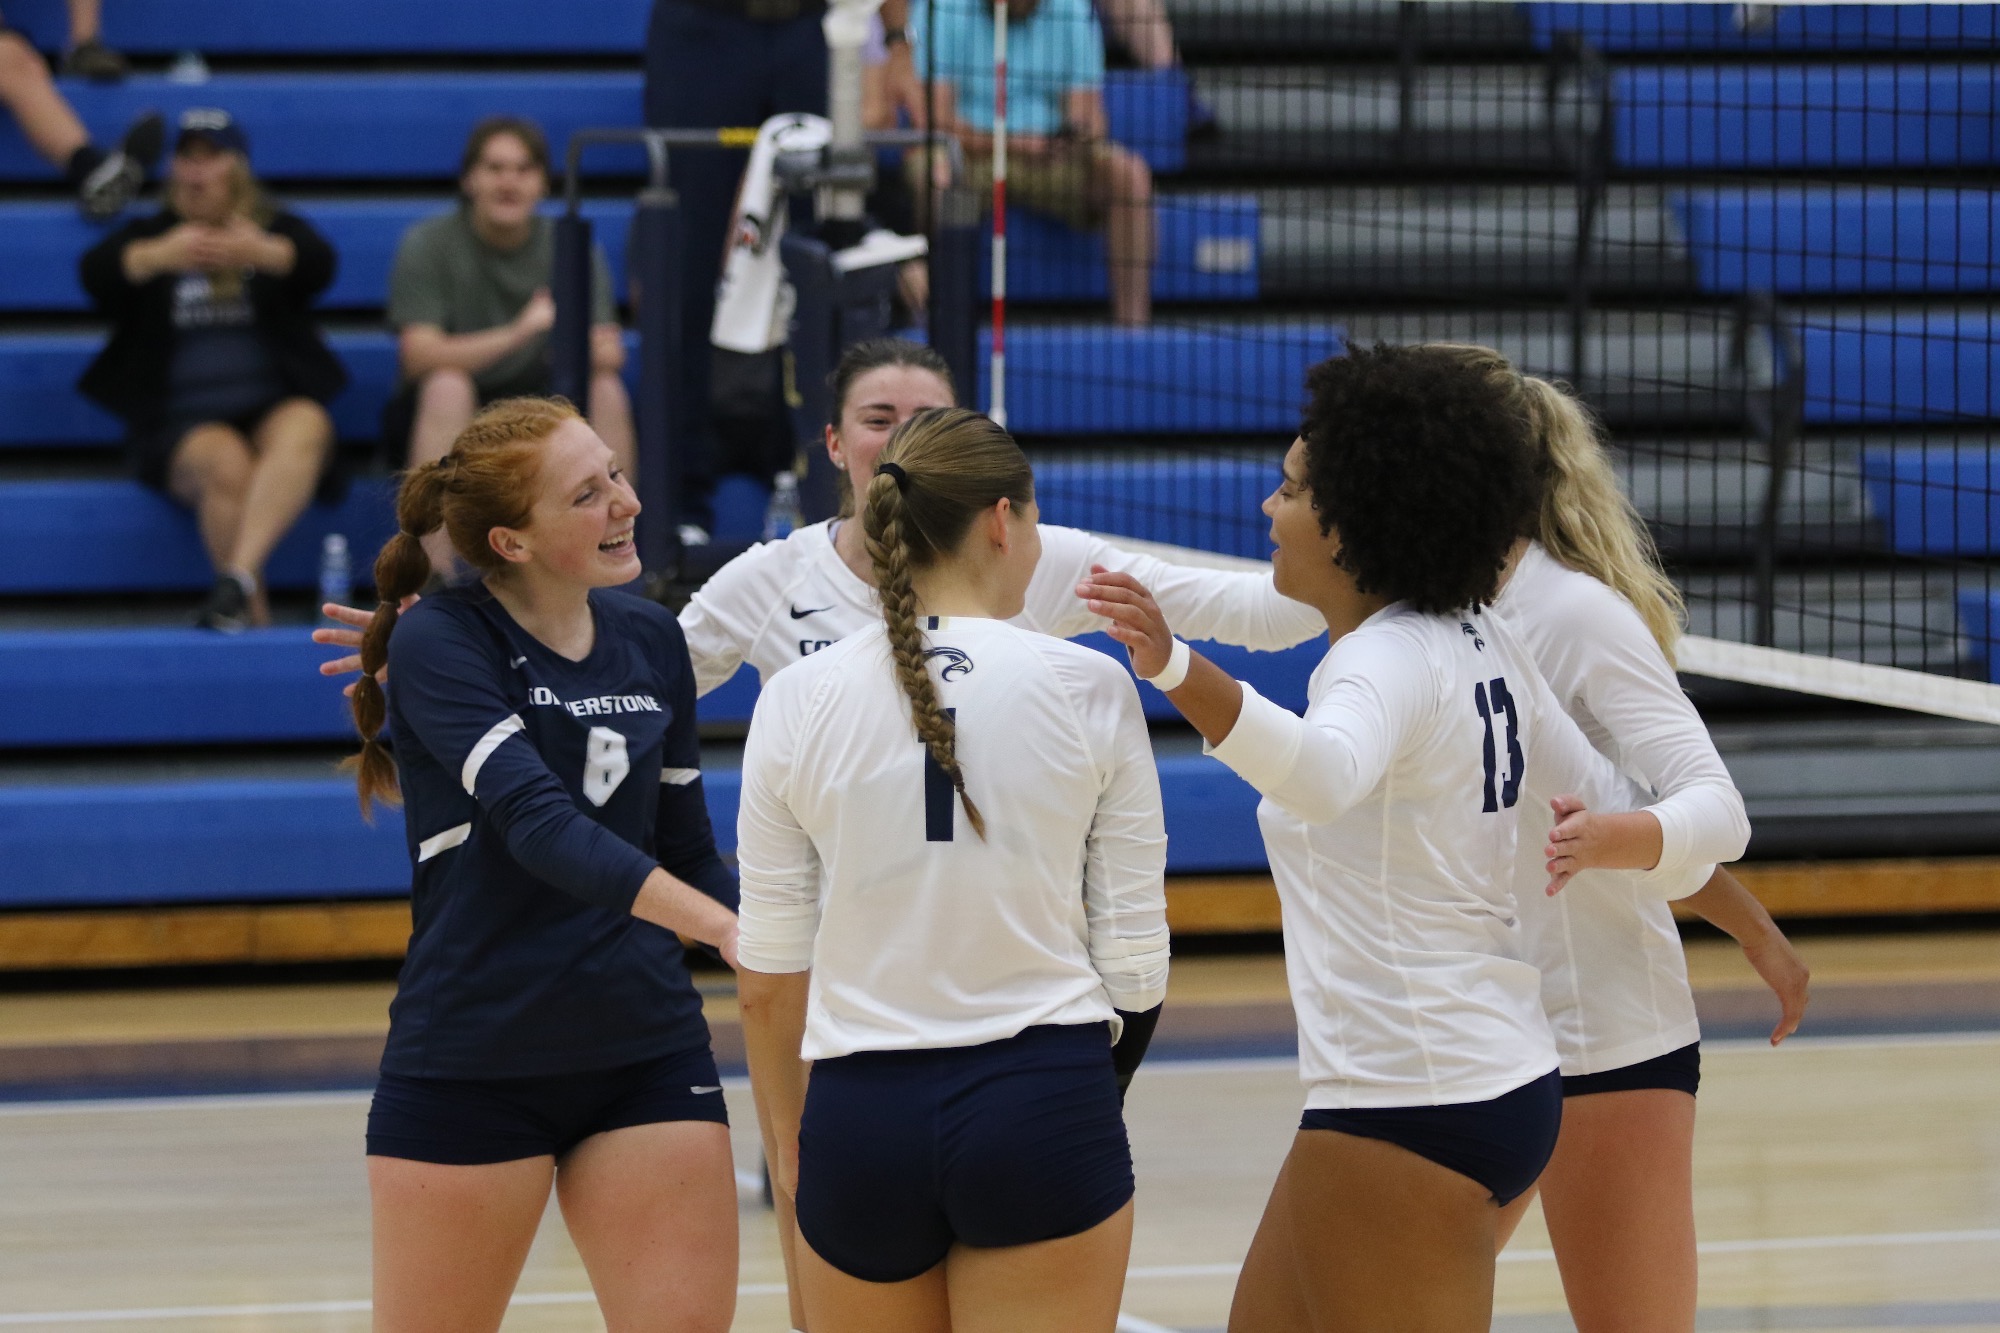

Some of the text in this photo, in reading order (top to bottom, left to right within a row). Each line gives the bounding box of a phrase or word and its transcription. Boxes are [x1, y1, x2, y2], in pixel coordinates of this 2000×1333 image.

[799, 640, 840, 656] CO
[528, 687, 663, 717] OERSTONE
[583, 726, 630, 807] 8
[918, 708, 956, 841] 1
[1475, 677, 1524, 813] 13
